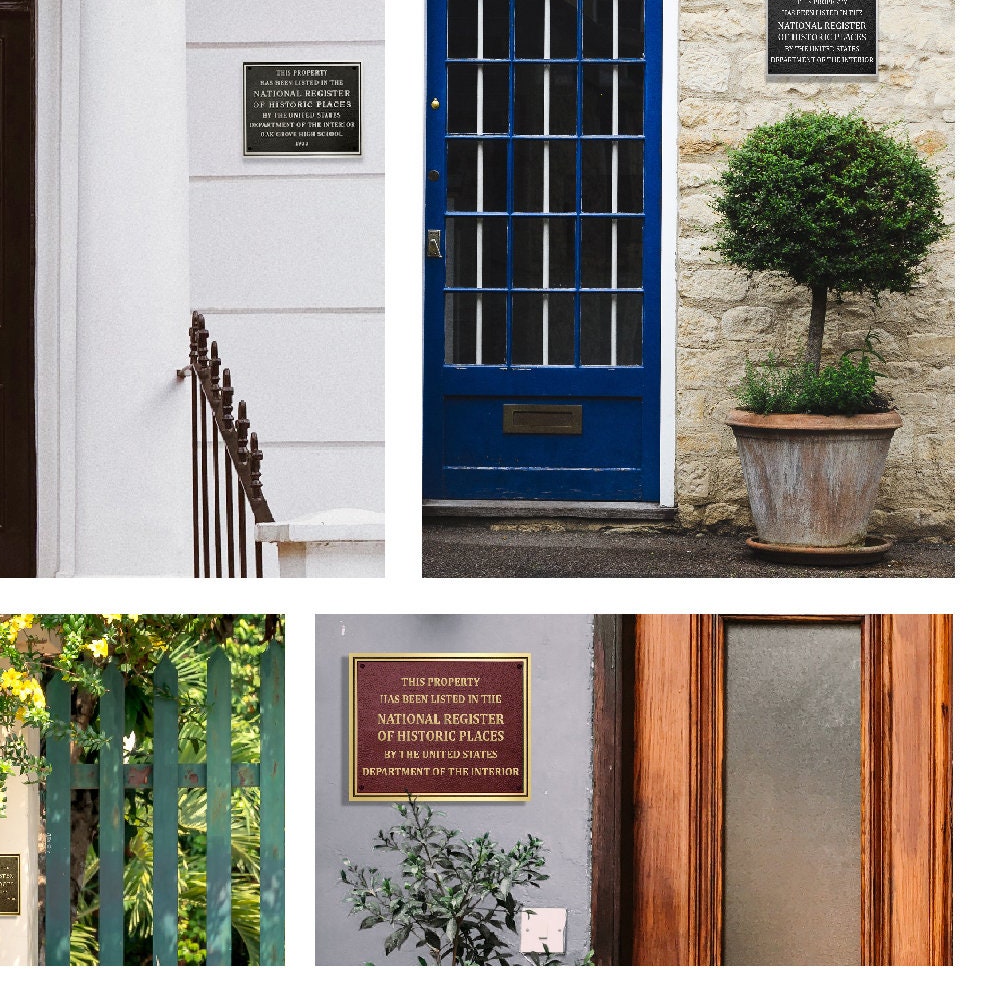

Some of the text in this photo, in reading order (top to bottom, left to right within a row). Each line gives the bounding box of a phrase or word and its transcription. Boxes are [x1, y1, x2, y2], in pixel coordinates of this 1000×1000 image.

[401, 678, 480, 687] THIS PROPERTY
[380, 695, 502, 703] HAS BEEN LISTED IN THE
[377, 714, 504, 725] NATIONAL REGISTER
[377, 731, 505, 741] OF HISTORIC PLACES
[384, 750, 498, 759] BY THE UNITED STATES
[362, 768, 519, 776] DEPARTMENT OF THE INTERIOR
